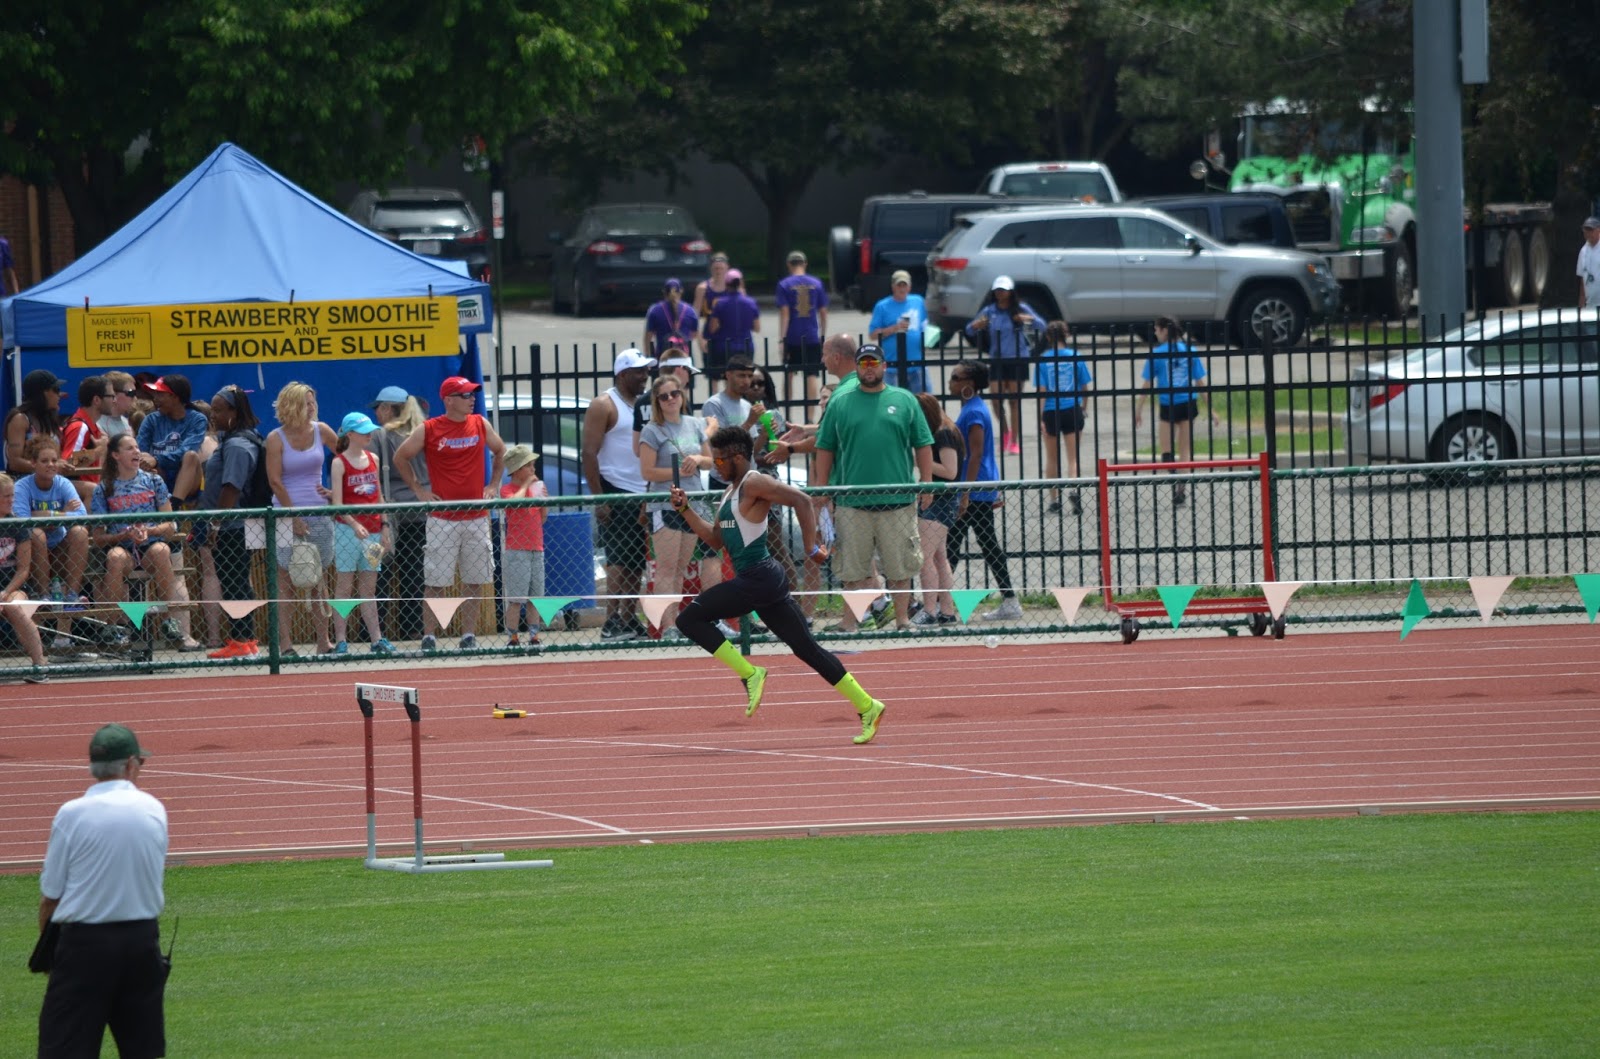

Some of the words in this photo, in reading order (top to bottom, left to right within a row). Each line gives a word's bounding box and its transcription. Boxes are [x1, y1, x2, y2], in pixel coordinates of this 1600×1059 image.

[170, 306, 320, 329] STRAWBERRY
[327, 302, 441, 325] SMOOTHIE
[91, 318, 118, 326] MADE
[120, 317, 144, 325] WITH
[96, 330, 135, 340] FRESH
[293, 326, 319, 337] AND
[99, 342, 133, 353] FRUIT
[187, 336, 333, 359] LEMONADE
[341, 333, 426, 355] SLUSH
[719, 519, 736, 529] VILLE
